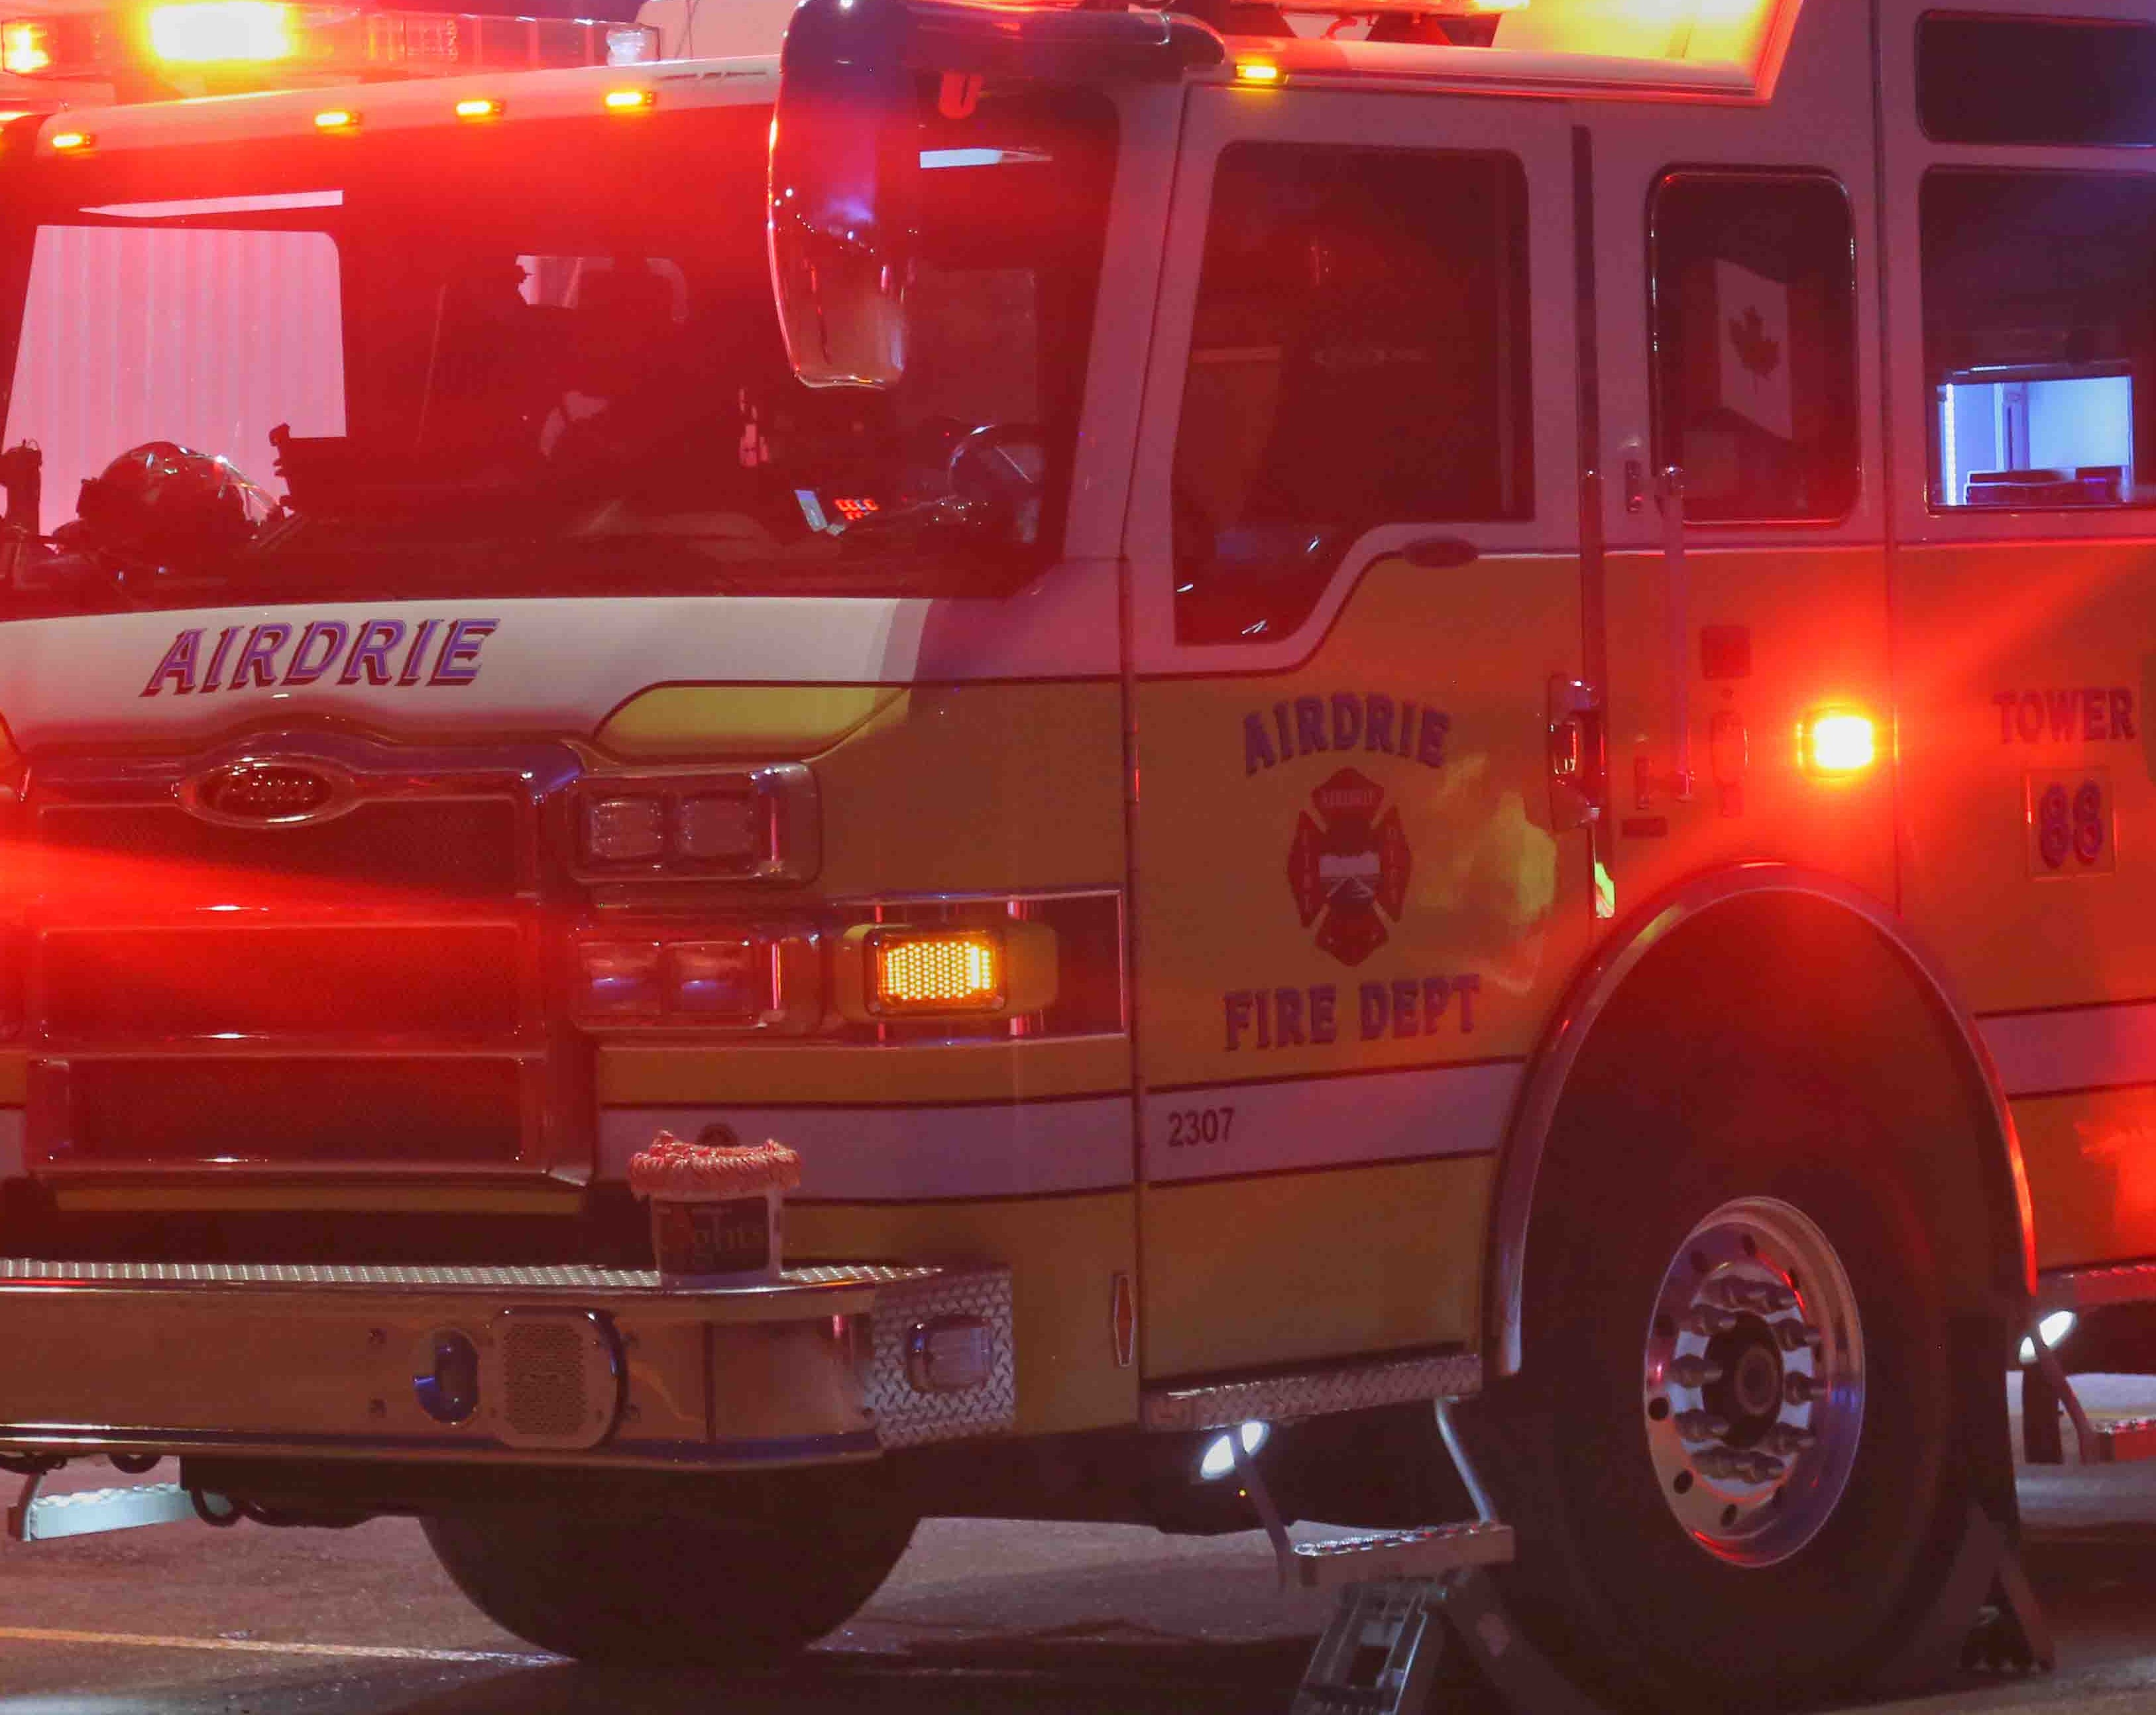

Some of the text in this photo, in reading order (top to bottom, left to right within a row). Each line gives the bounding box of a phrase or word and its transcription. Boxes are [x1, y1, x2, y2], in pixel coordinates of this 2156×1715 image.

[139, 618, 500, 697] AIRDRIE
[1243, 692, 1451, 778] AIRDRIE
[1991, 686, 2137, 744] TOWER
[1223, 973, 1480, 1052] FIRE DEPT
[1168, 1106, 1235, 1148] 2307
